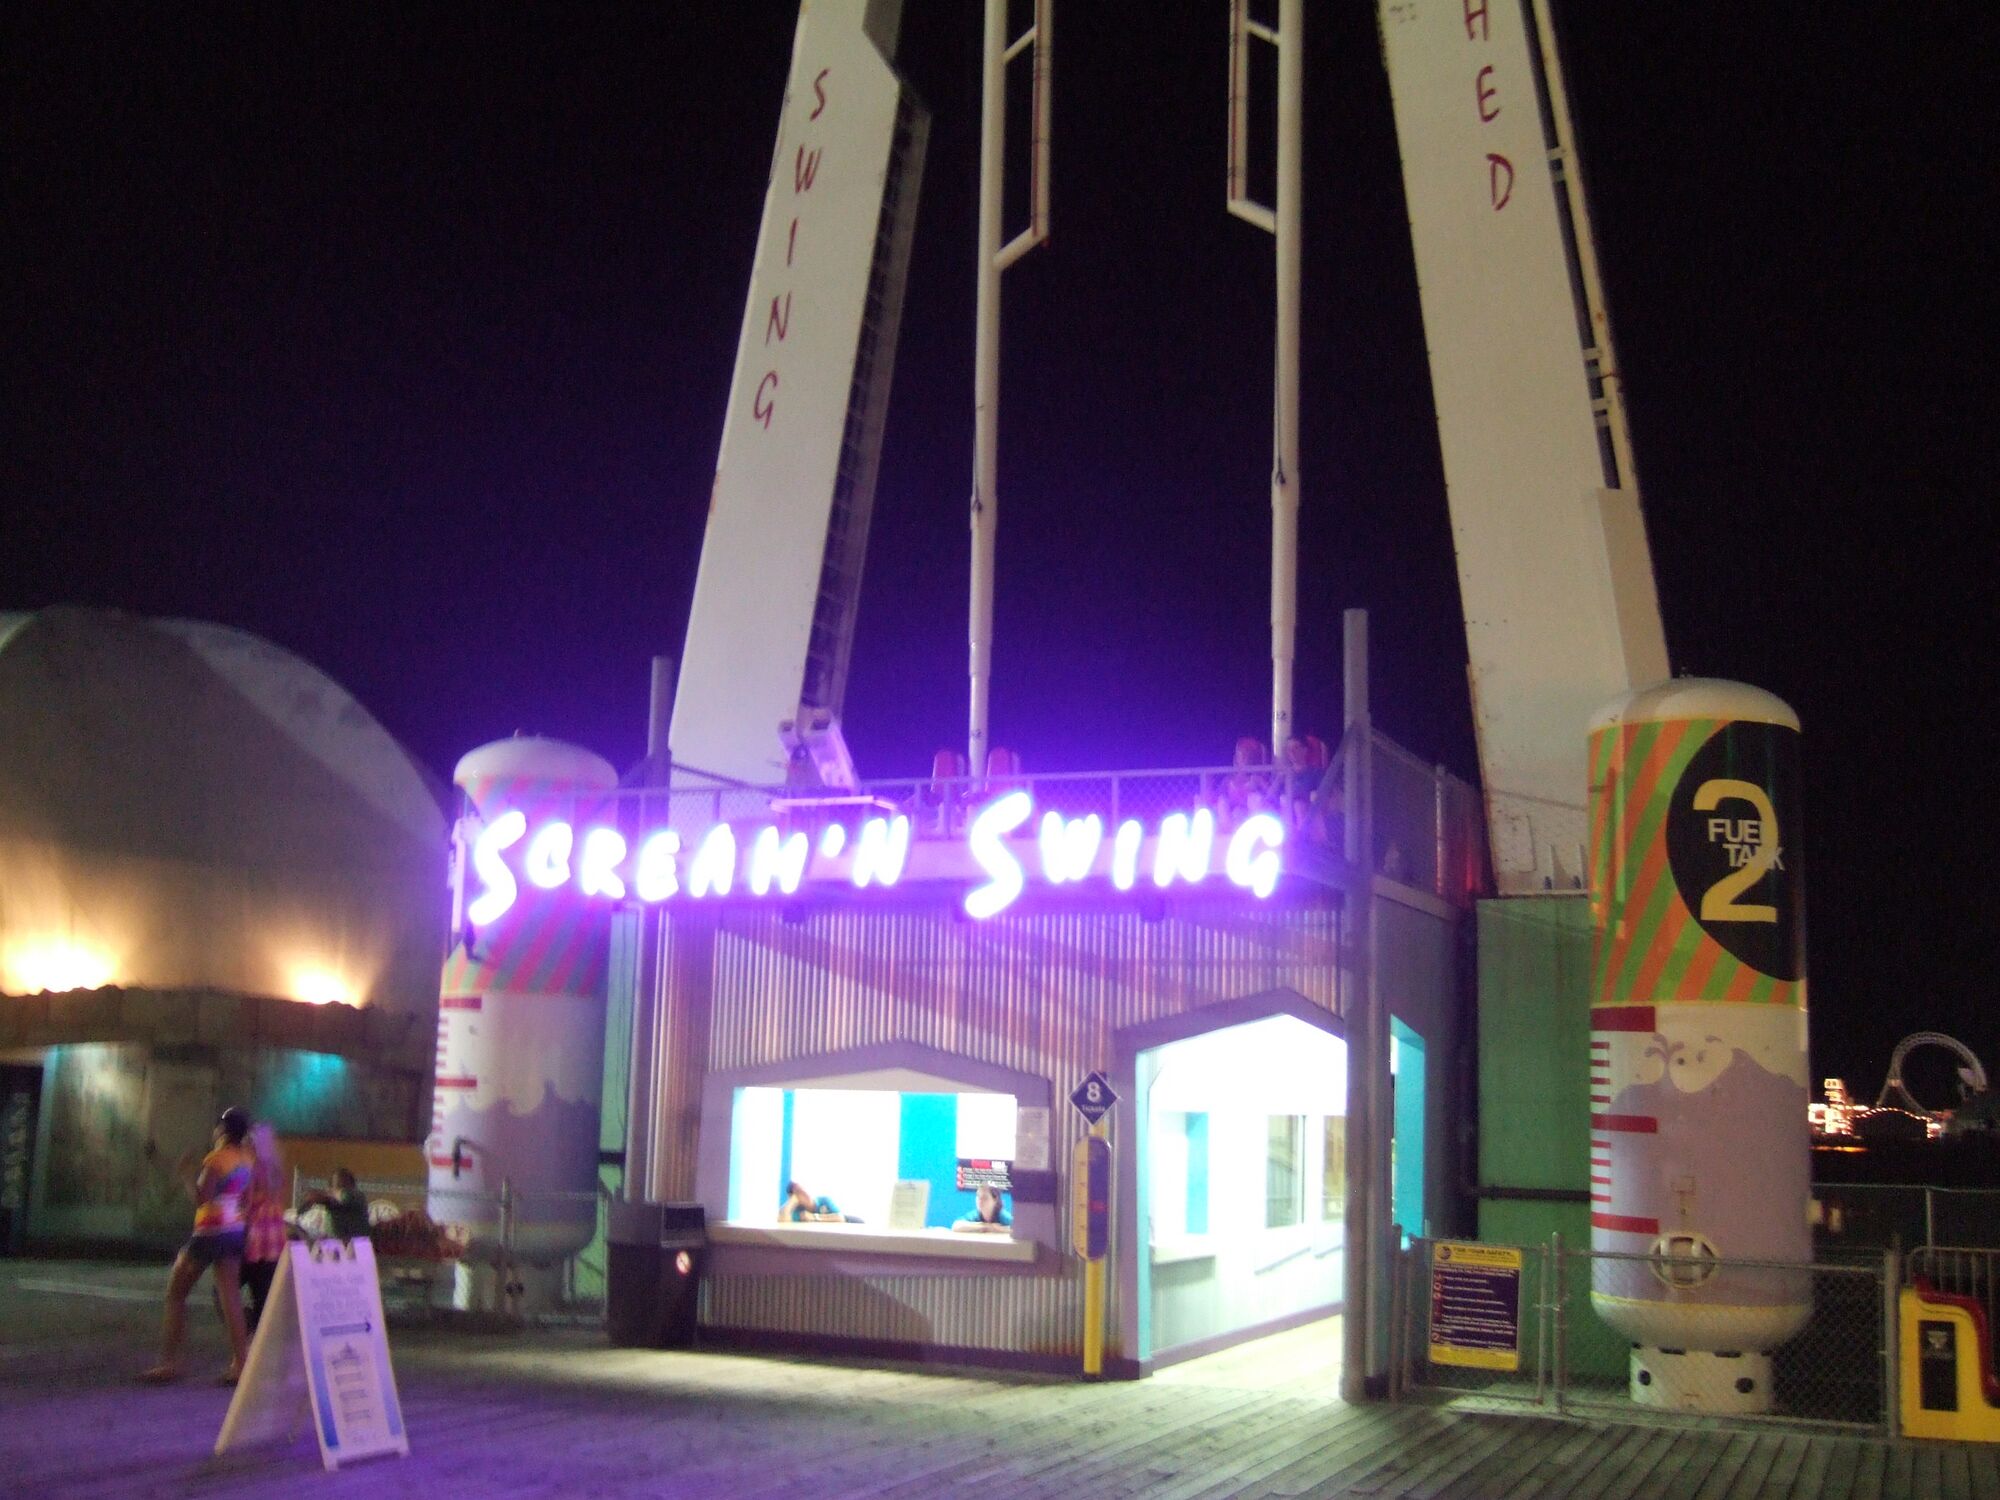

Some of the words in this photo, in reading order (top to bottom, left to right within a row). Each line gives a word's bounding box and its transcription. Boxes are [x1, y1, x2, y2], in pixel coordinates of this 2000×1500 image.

[753, 68, 831, 429] SWING
[468, 810, 910, 926] SCREAM'N
[964, 791, 1284, 919] SWING
[1692, 778, 1779, 923] 2
[1707, 817, 1768, 844] FUE
[1086, 1081, 1101, 1104] 8
